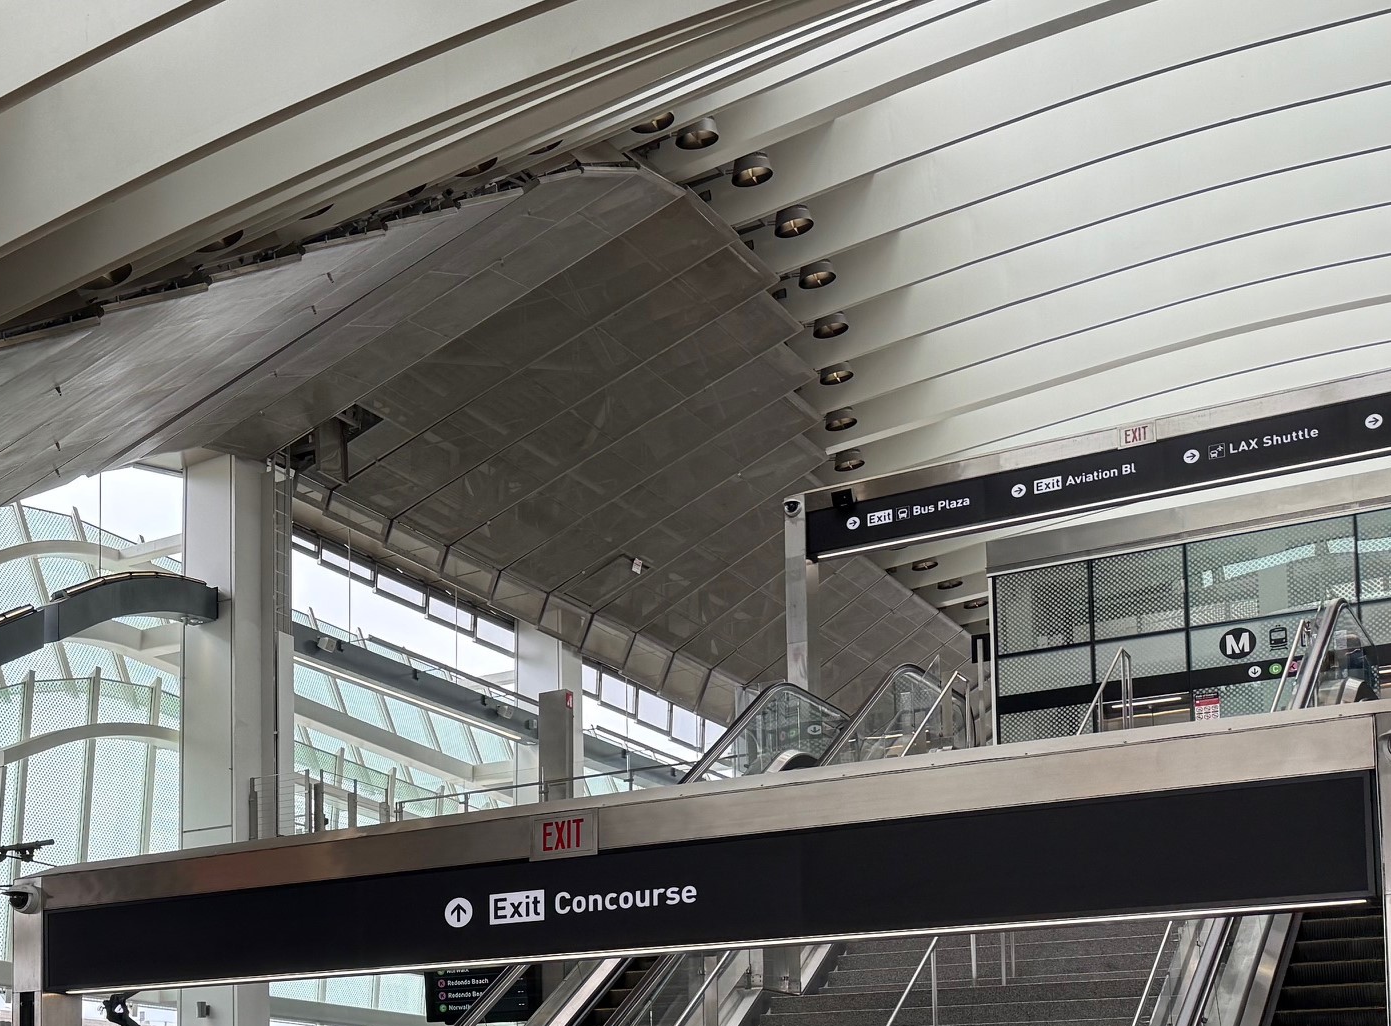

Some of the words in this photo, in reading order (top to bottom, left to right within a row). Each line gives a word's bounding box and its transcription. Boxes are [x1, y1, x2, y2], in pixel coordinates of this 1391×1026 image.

[1124, 425, 1149, 444] EXIT
[1229, 438, 1259, 454] LAX
[1263, 428, 1319, 447] Shuttle
[1035, 477, 1061, 493] Exit
[1065, 467, 1118, 486] Aviation
[1121, 462, 1136, 475] Bl
[869, 511, 893, 524] Exit
[913, 505, 935, 516] Bus
[937, 497, 970, 511] Plaza
[1224, 631, 1250, 656] M
[542, 818, 584, 852] EXIT
[493, 895, 541, 920] Exit
[554, 885, 698, 915] Concourse
